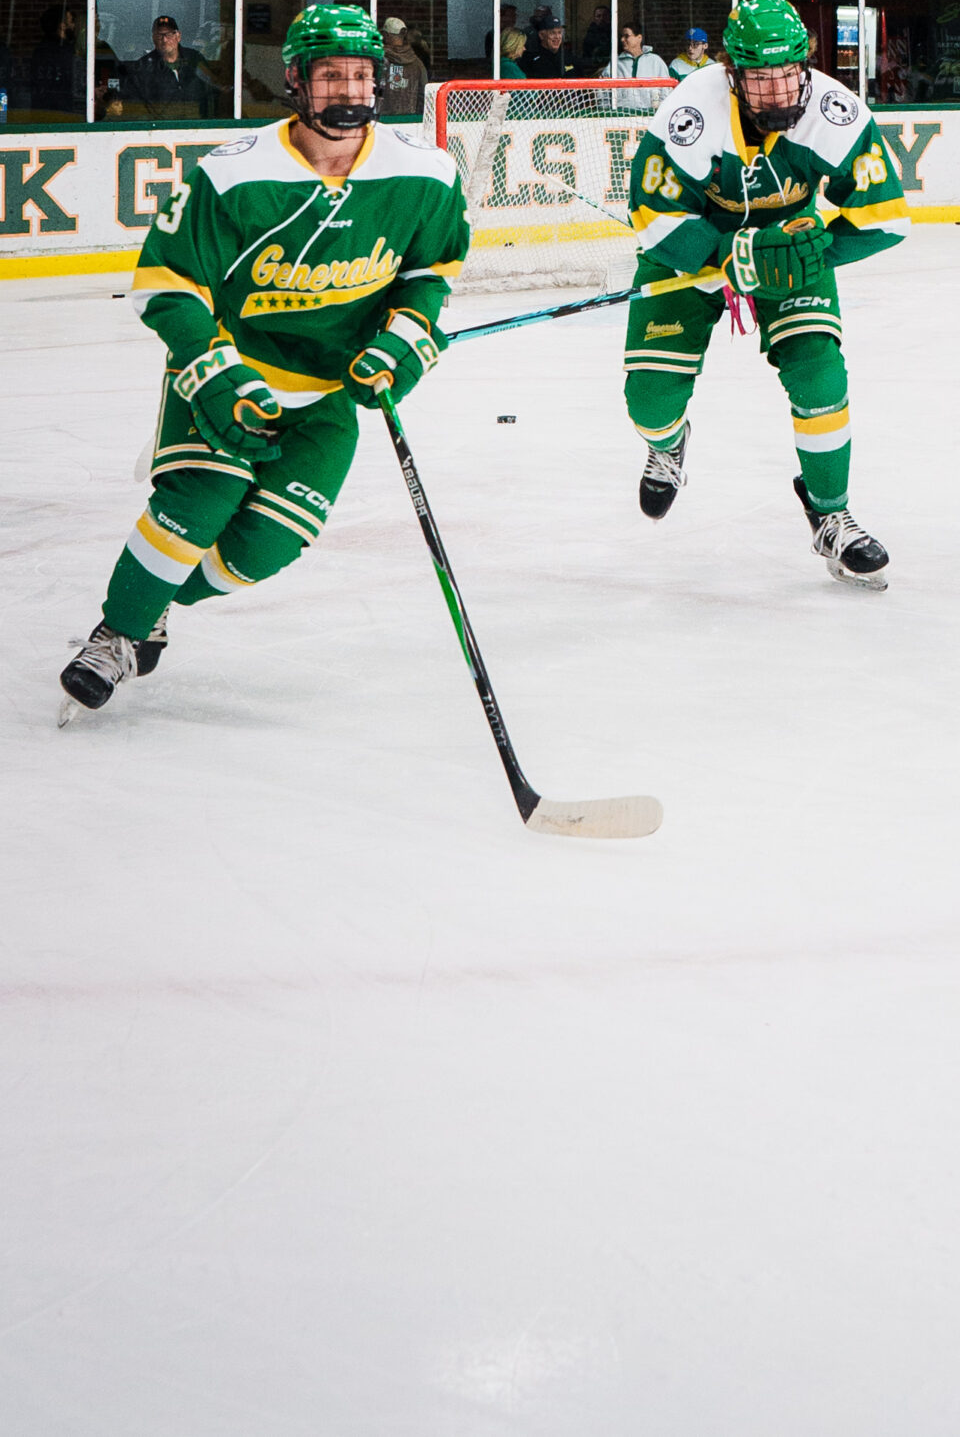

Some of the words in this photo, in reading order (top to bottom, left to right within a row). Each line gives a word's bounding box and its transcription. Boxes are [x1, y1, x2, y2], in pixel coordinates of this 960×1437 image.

[762, 44, 790, 55] CCM
[252, 236, 403, 292] Generals
[779, 296, 832, 312] CCM
[174, 349, 227, 399] CM
[286, 481, 335, 517] CCM
[157, 511, 189, 536] CCM
